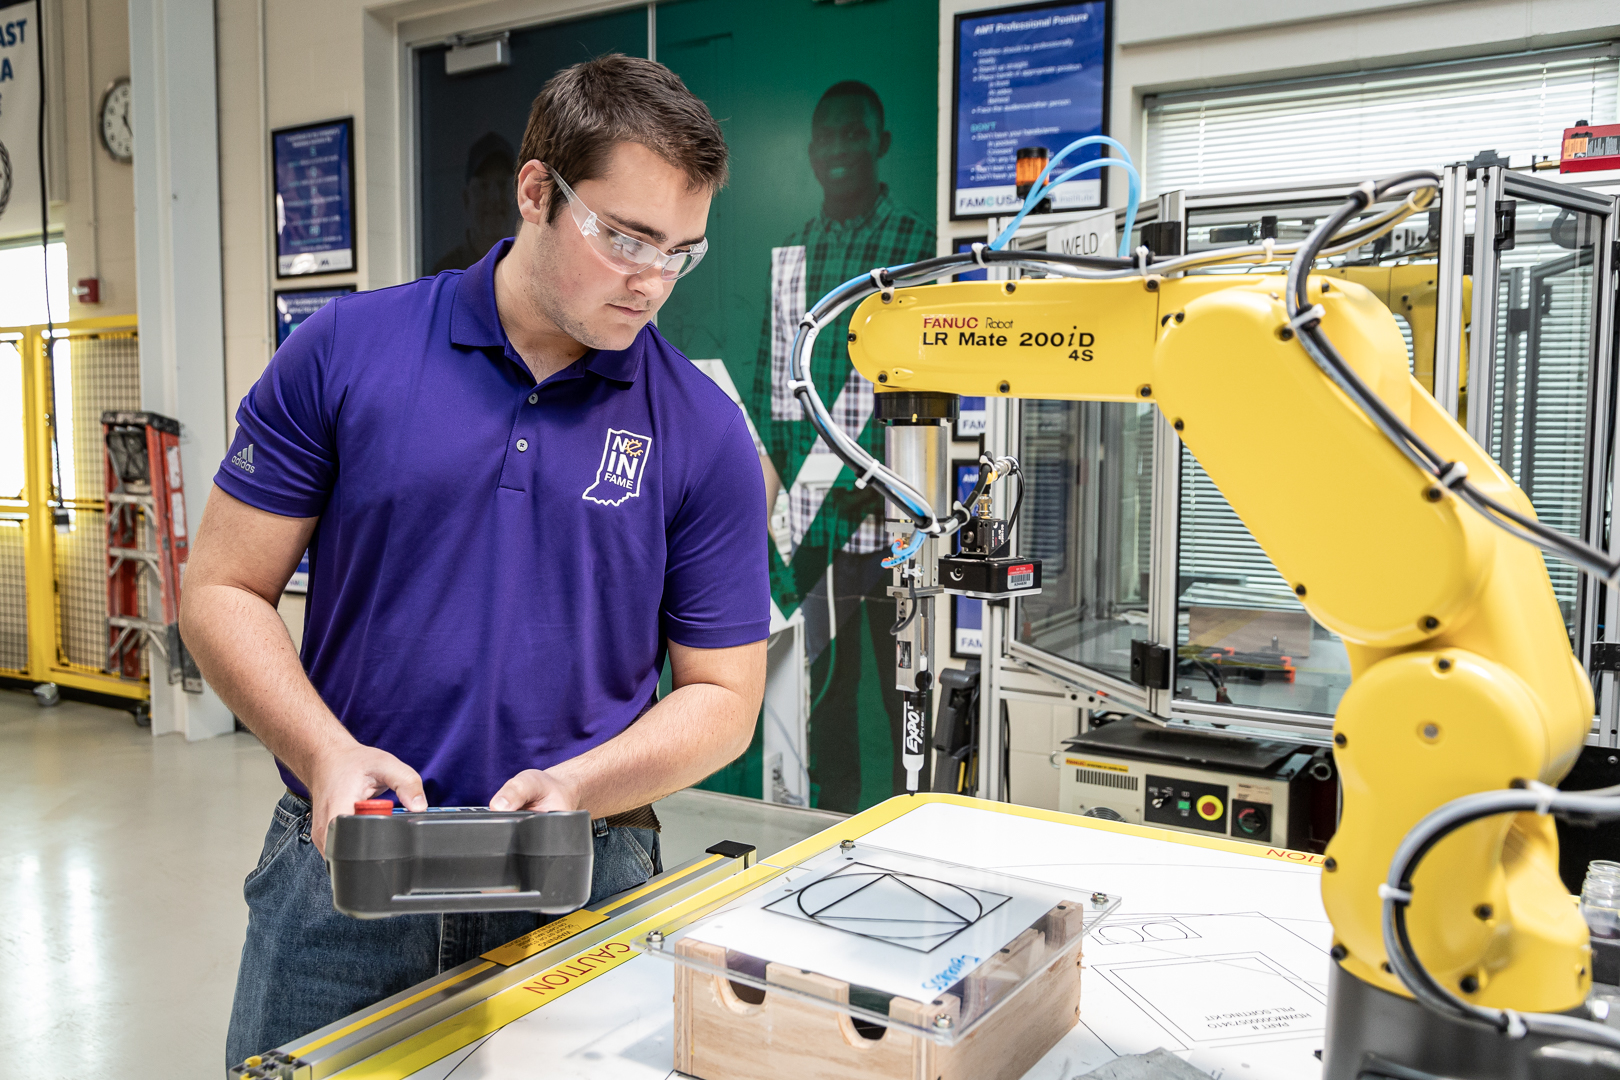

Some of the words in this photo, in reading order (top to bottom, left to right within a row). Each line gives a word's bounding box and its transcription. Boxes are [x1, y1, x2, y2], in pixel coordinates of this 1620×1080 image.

[995, 16, 1052, 33] Professional
[1052, 13, 1089, 26] Posture
[1062, 232, 1099, 255] WELD
[923, 317, 979, 329] FANUC
[985, 317, 1014, 329] Robot
[922, 332, 948, 346] LR
[958, 332, 1008, 347] Mate
[1019, 325, 1095, 348] 200iD
[1068, 350, 1094, 361] 4S
[231, 455, 255, 474] adidas
[607, 450, 639, 480] IN
[604, 472, 634, 490] FAME
[523, 942, 630, 995] CAUTION
[1222, 1009, 1272, 1018] SORTING
